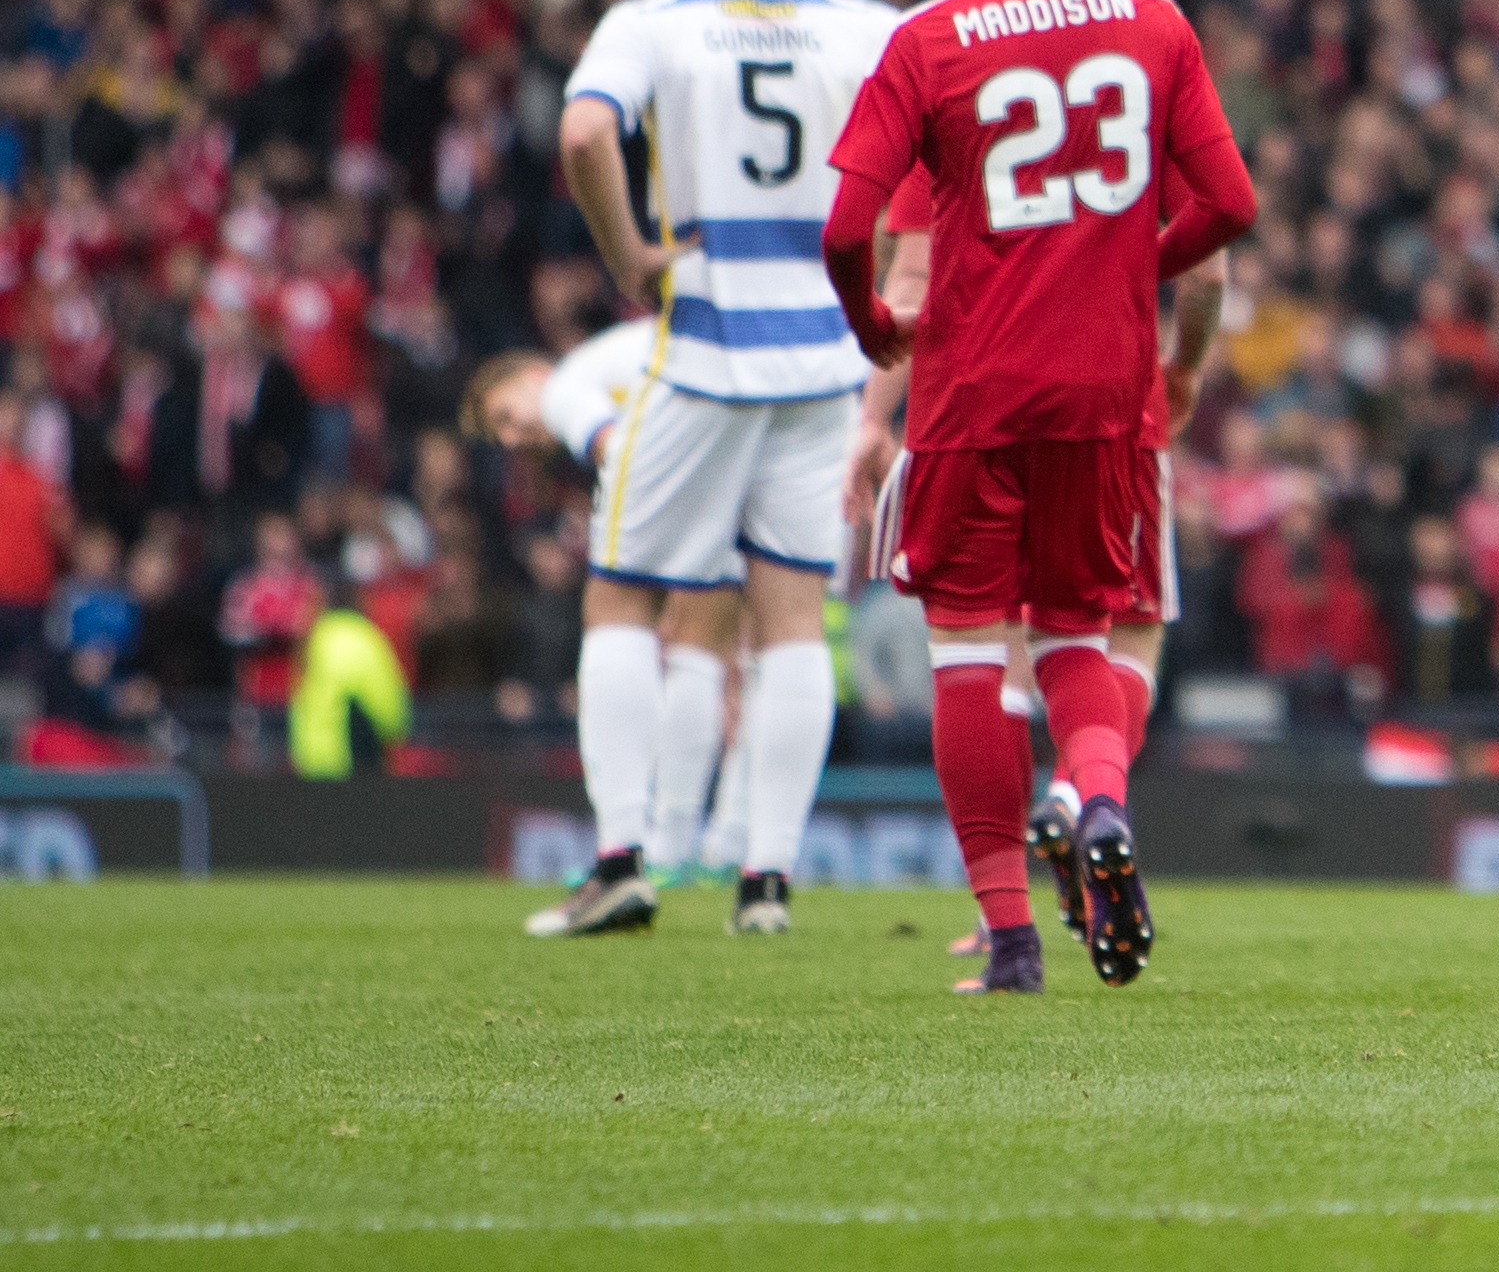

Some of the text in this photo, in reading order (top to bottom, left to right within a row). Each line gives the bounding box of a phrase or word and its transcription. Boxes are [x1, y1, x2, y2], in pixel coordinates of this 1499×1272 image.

[703, 26, 822, 54] GUNNING
[739, 59, 803, 188] 5
[975, 52, 1152, 233] 23
